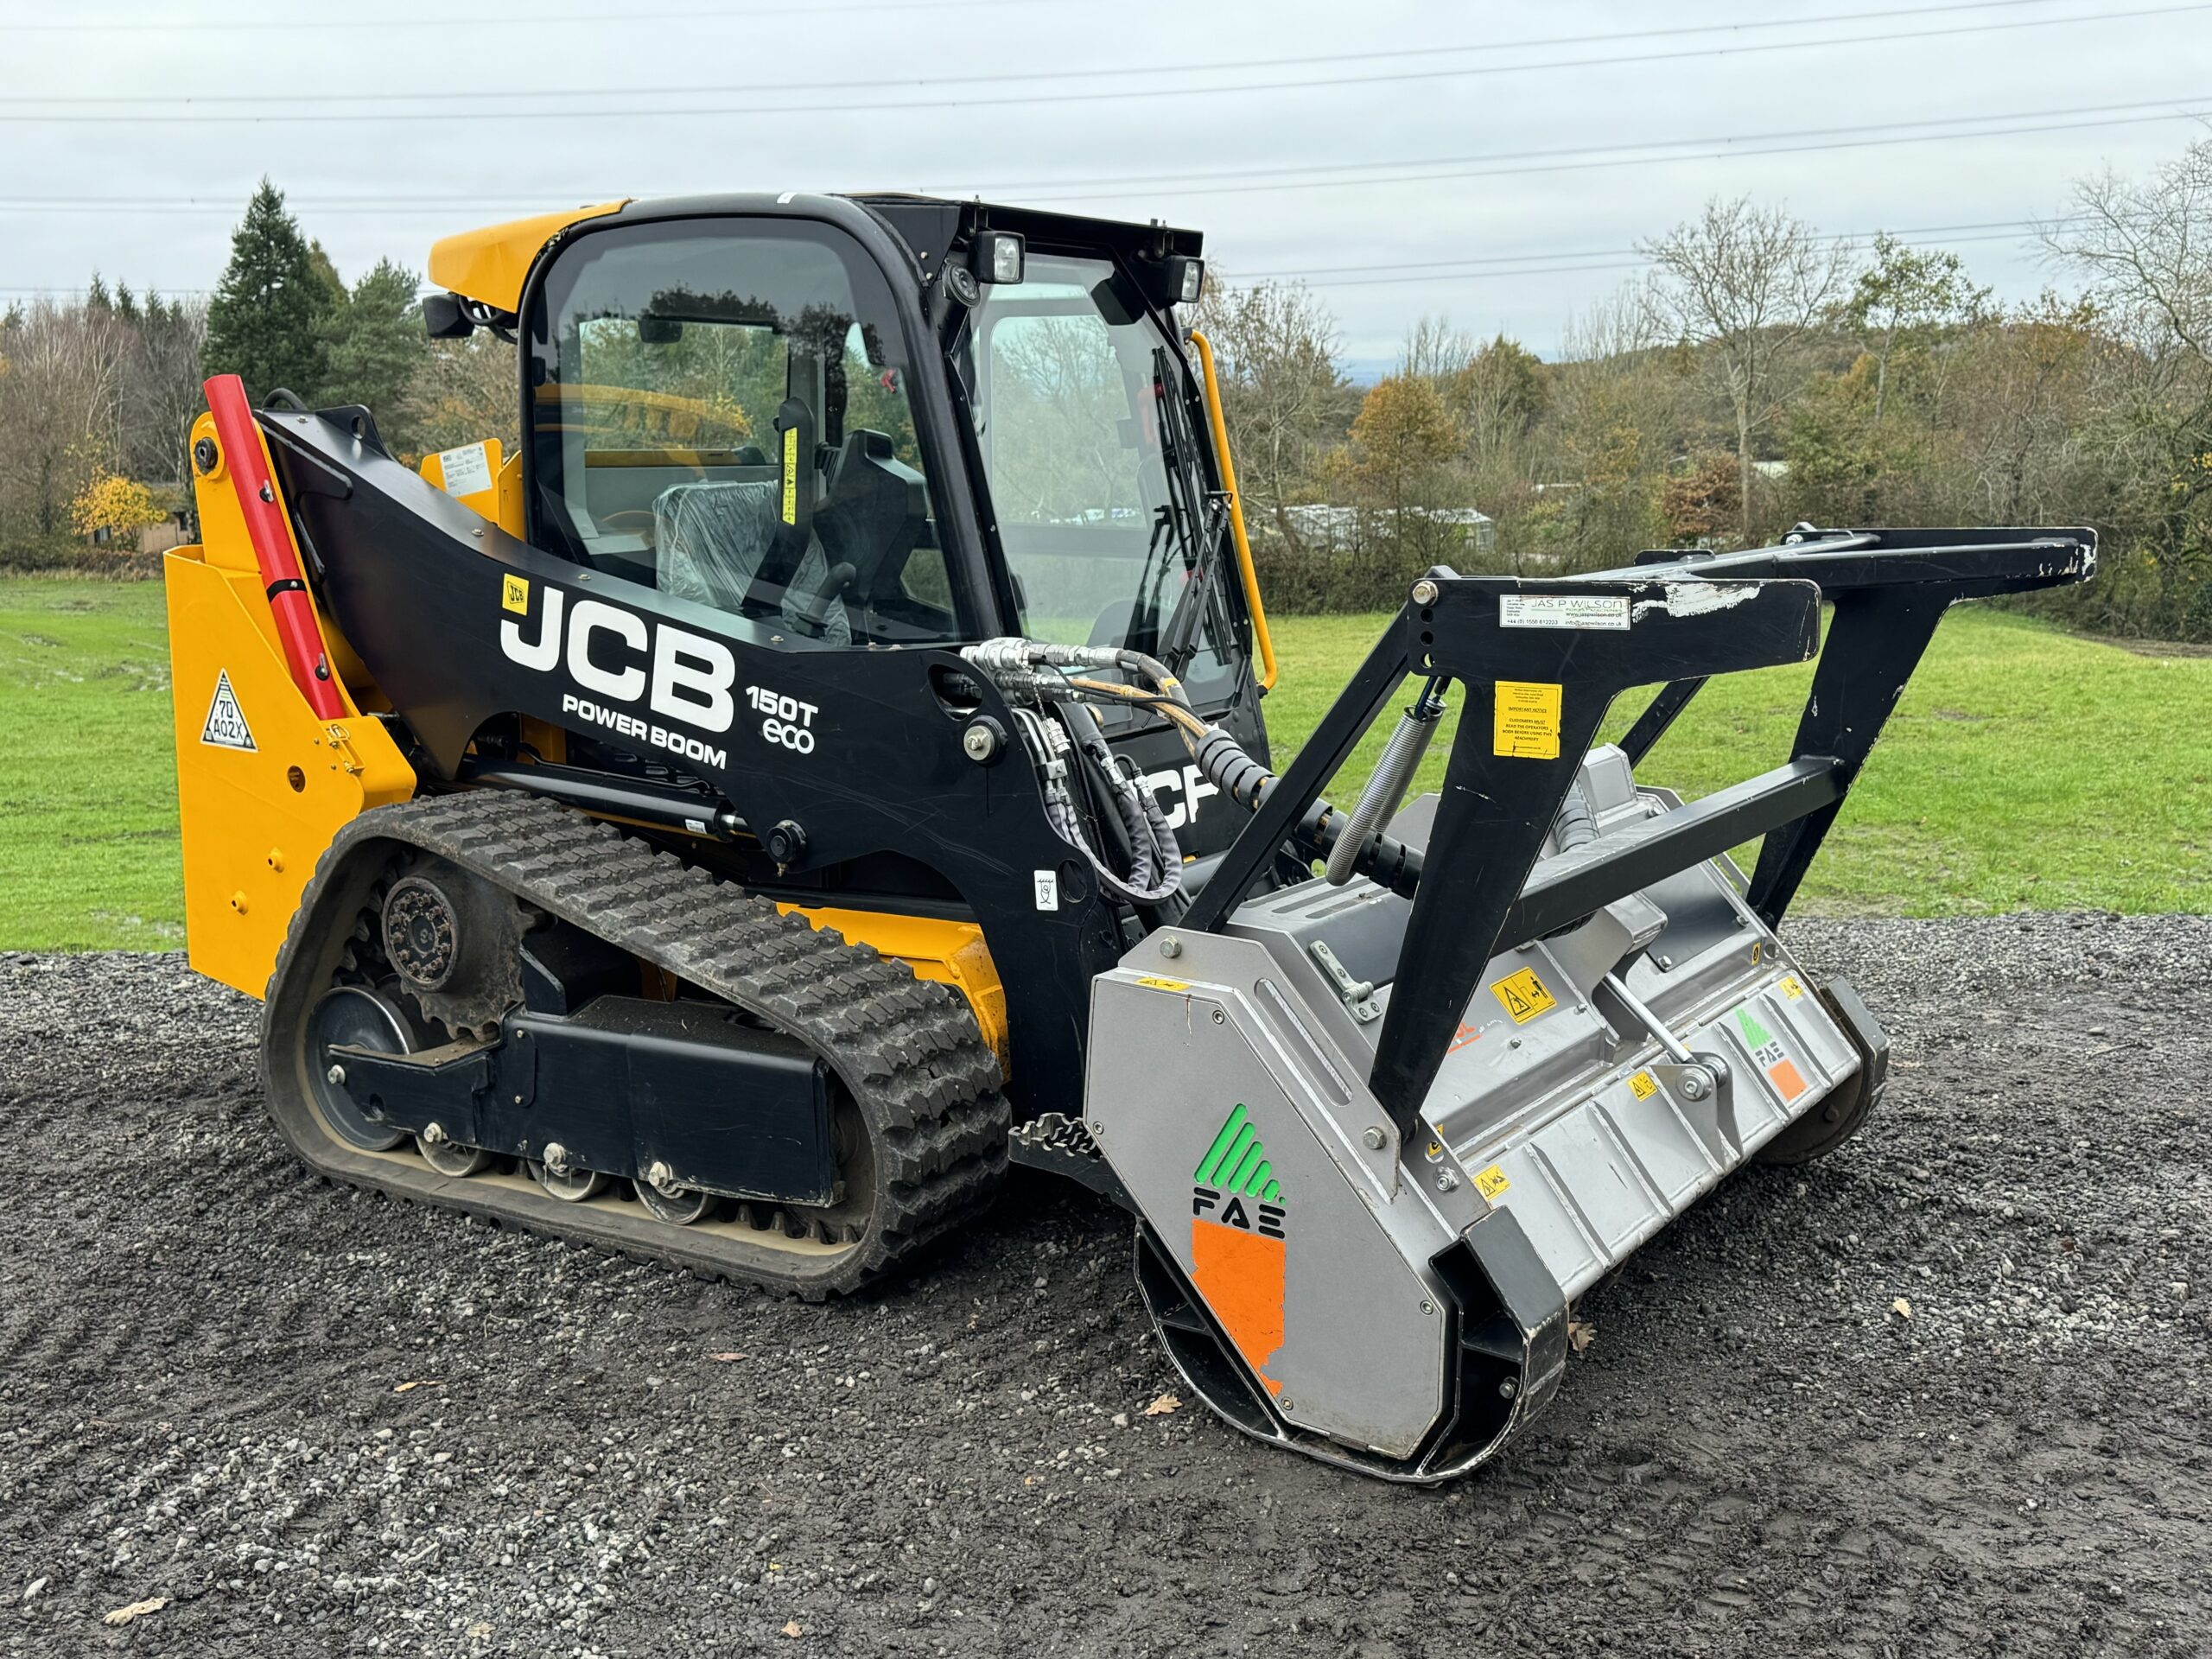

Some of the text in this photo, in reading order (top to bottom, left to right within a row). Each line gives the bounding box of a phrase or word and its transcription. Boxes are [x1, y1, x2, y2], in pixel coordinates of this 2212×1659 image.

[510, 584, 524, 602] JCB
[1531, 600, 1554, 608] JAS
[499, 585, 736, 734] JCB
[745, 685, 819, 728] 150T
[562, 693, 727, 770] POWER BOOM
[1755, 1040, 1784, 1068] FAE
[1192, 1186, 1287, 1239] FAE
